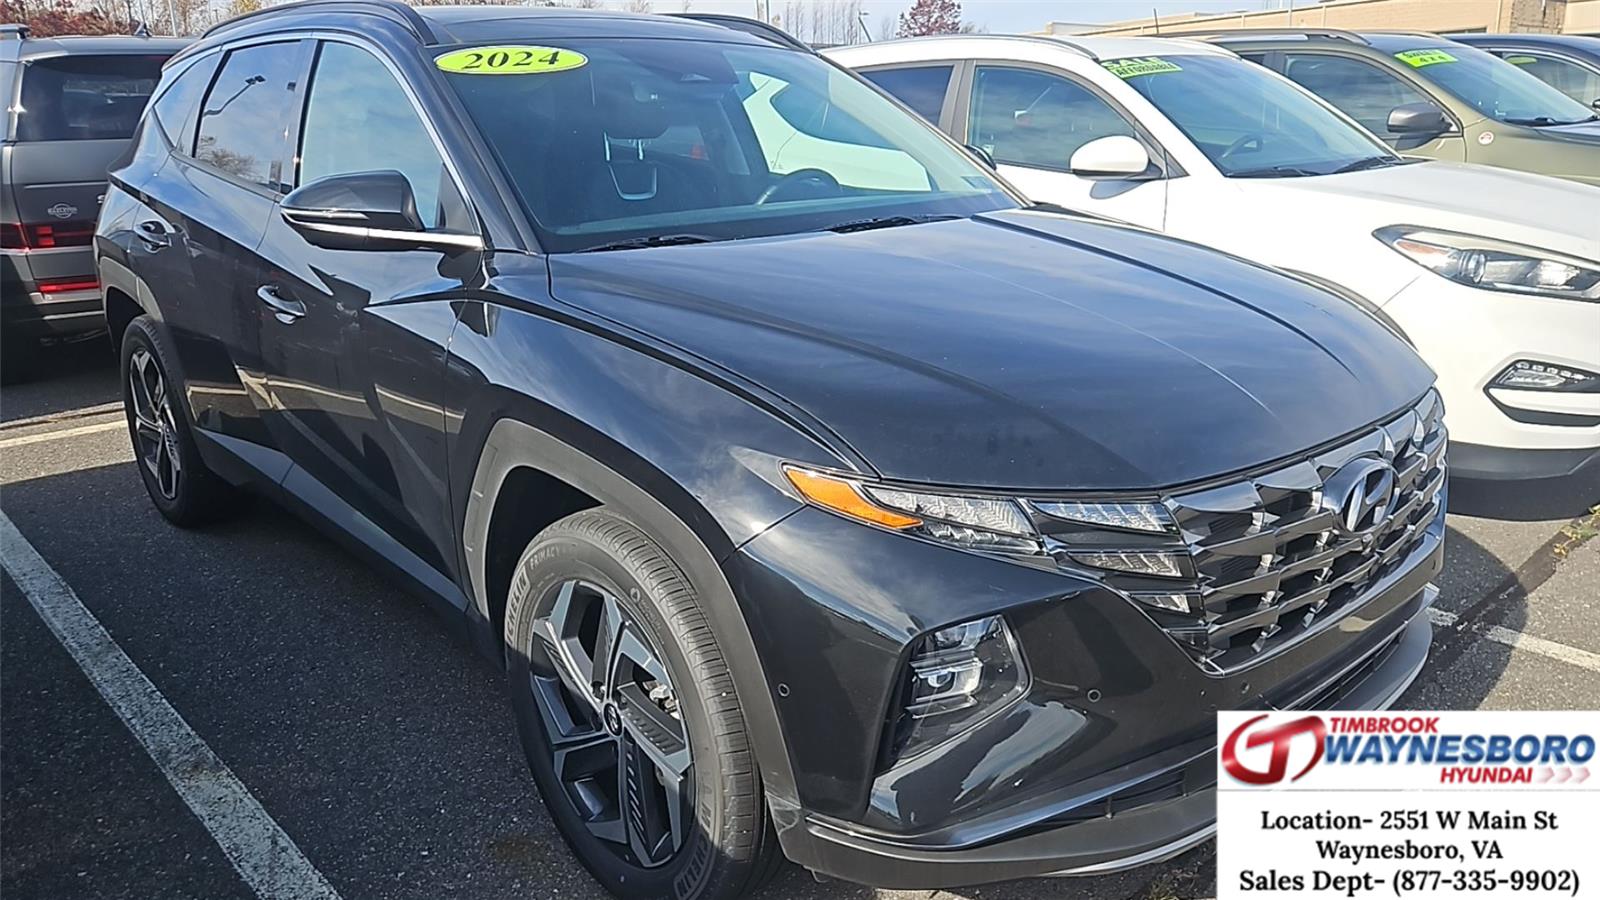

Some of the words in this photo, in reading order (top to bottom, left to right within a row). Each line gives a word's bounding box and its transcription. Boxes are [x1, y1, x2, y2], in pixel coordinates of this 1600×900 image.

[462, 51, 560, 69] 2024
[530, 546, 560, 570] PRIMACY
[505, 570, 529, 645] ICHELIN
